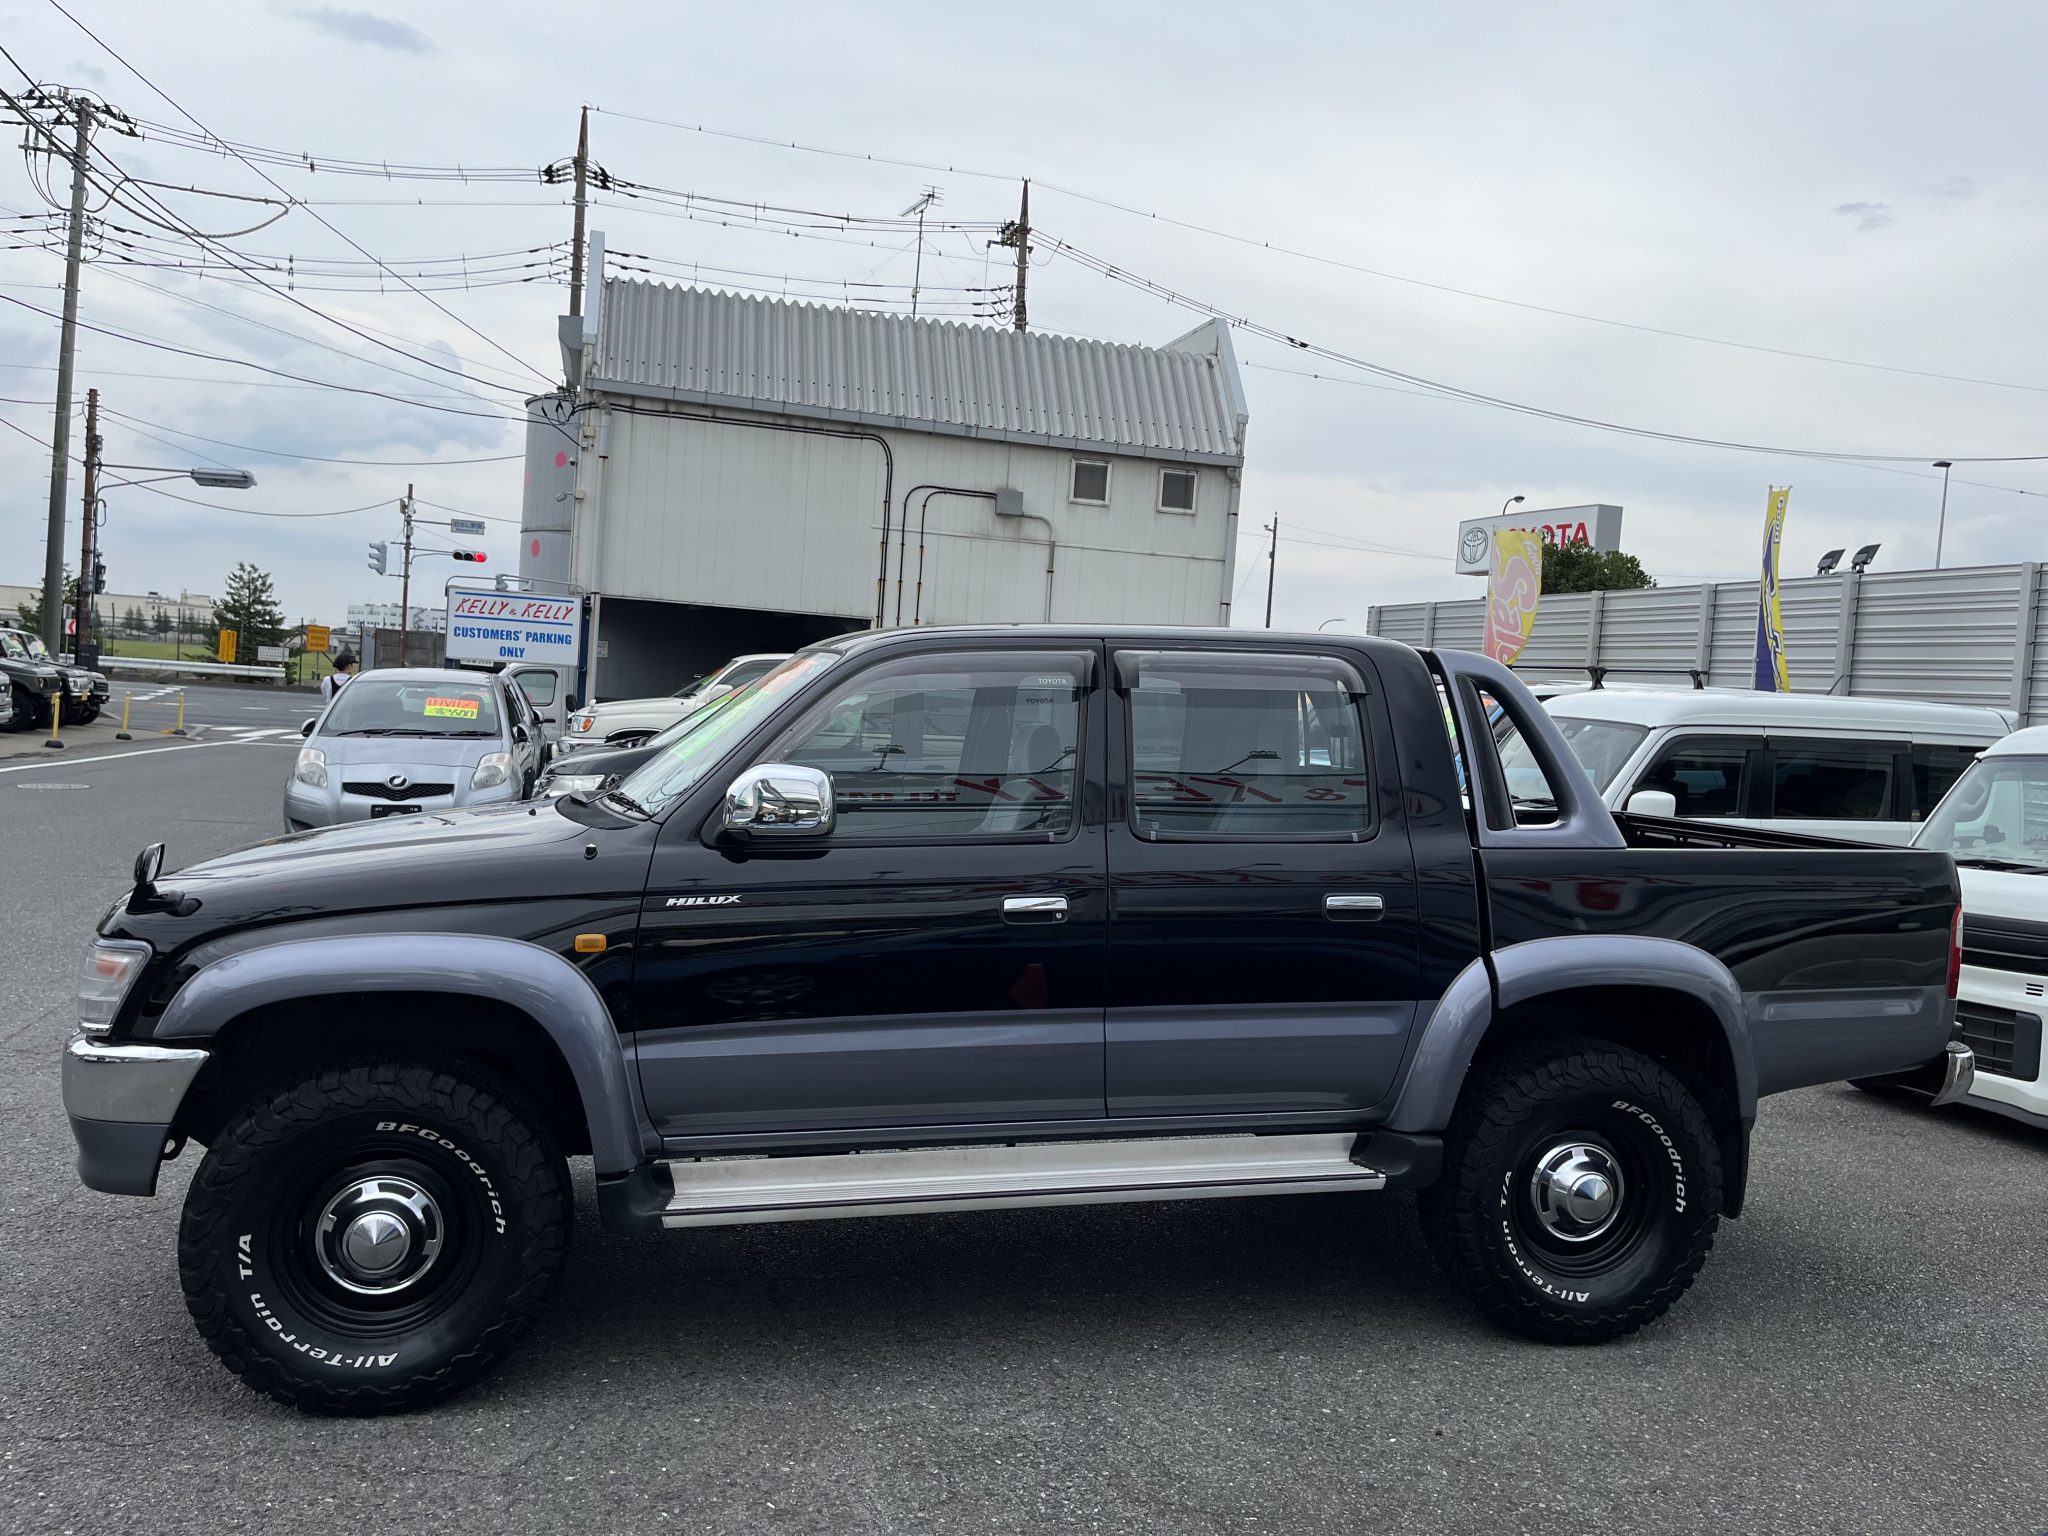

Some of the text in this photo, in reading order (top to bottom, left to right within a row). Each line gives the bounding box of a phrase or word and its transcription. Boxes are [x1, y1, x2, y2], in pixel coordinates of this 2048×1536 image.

[455, 597, 574, 620] KELLY & KELLY
[525, 631, 572, 645] PARKING
[499, 646, 526, 658] ONLY
[666, 894, 742, 907] HILUX
[376, 1121, 507, 1235] BFGoodrich
[1611, 1100, 1687, 1214] BFGoodrich
[1500, 1171, 1591, 1303] All-Terrain T/A
[239, 1233, 400, 1369] All-Terrain T/A
